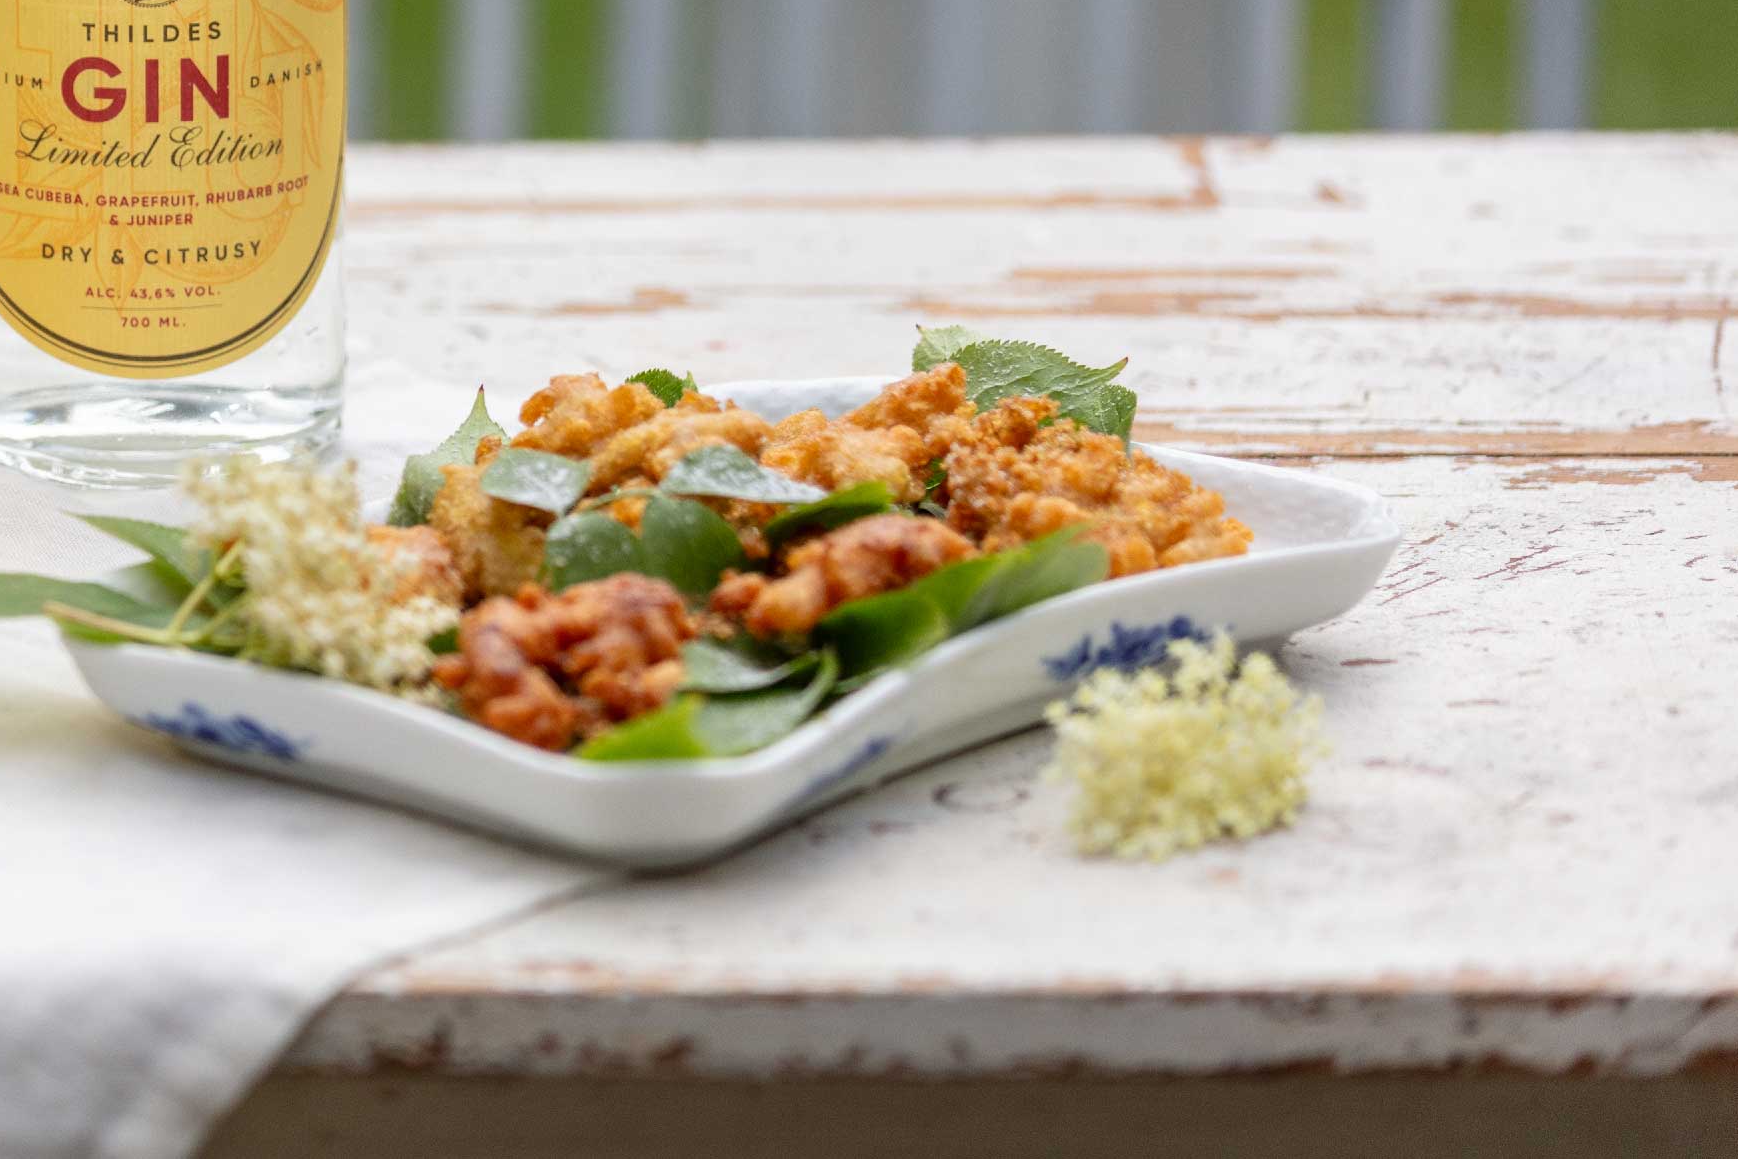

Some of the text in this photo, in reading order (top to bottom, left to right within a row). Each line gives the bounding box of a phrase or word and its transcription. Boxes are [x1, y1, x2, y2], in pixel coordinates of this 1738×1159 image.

[82, 21, 222, 43] THILDES
[250, 58, 324, 89] DANISH
[61, 54, 230, 123] GIN
[14, 118, 284, 171] Limited Edition
[25, 186, 90, 207] CUBEBA,
[96, 194, 200, 208] GRAPEFRUIT,
[206, 184, 273, 206] RHUBARB
[277, 175, 309, 194] ROOT
[109, 213, 194, 226] & JUNIPER
[41, 240, 262, 265] DRY & CITRUSY
[85, 285, 221, 300] ALC. 43,6% VOL.
[121, 317, 186, 328] 700 ML.
